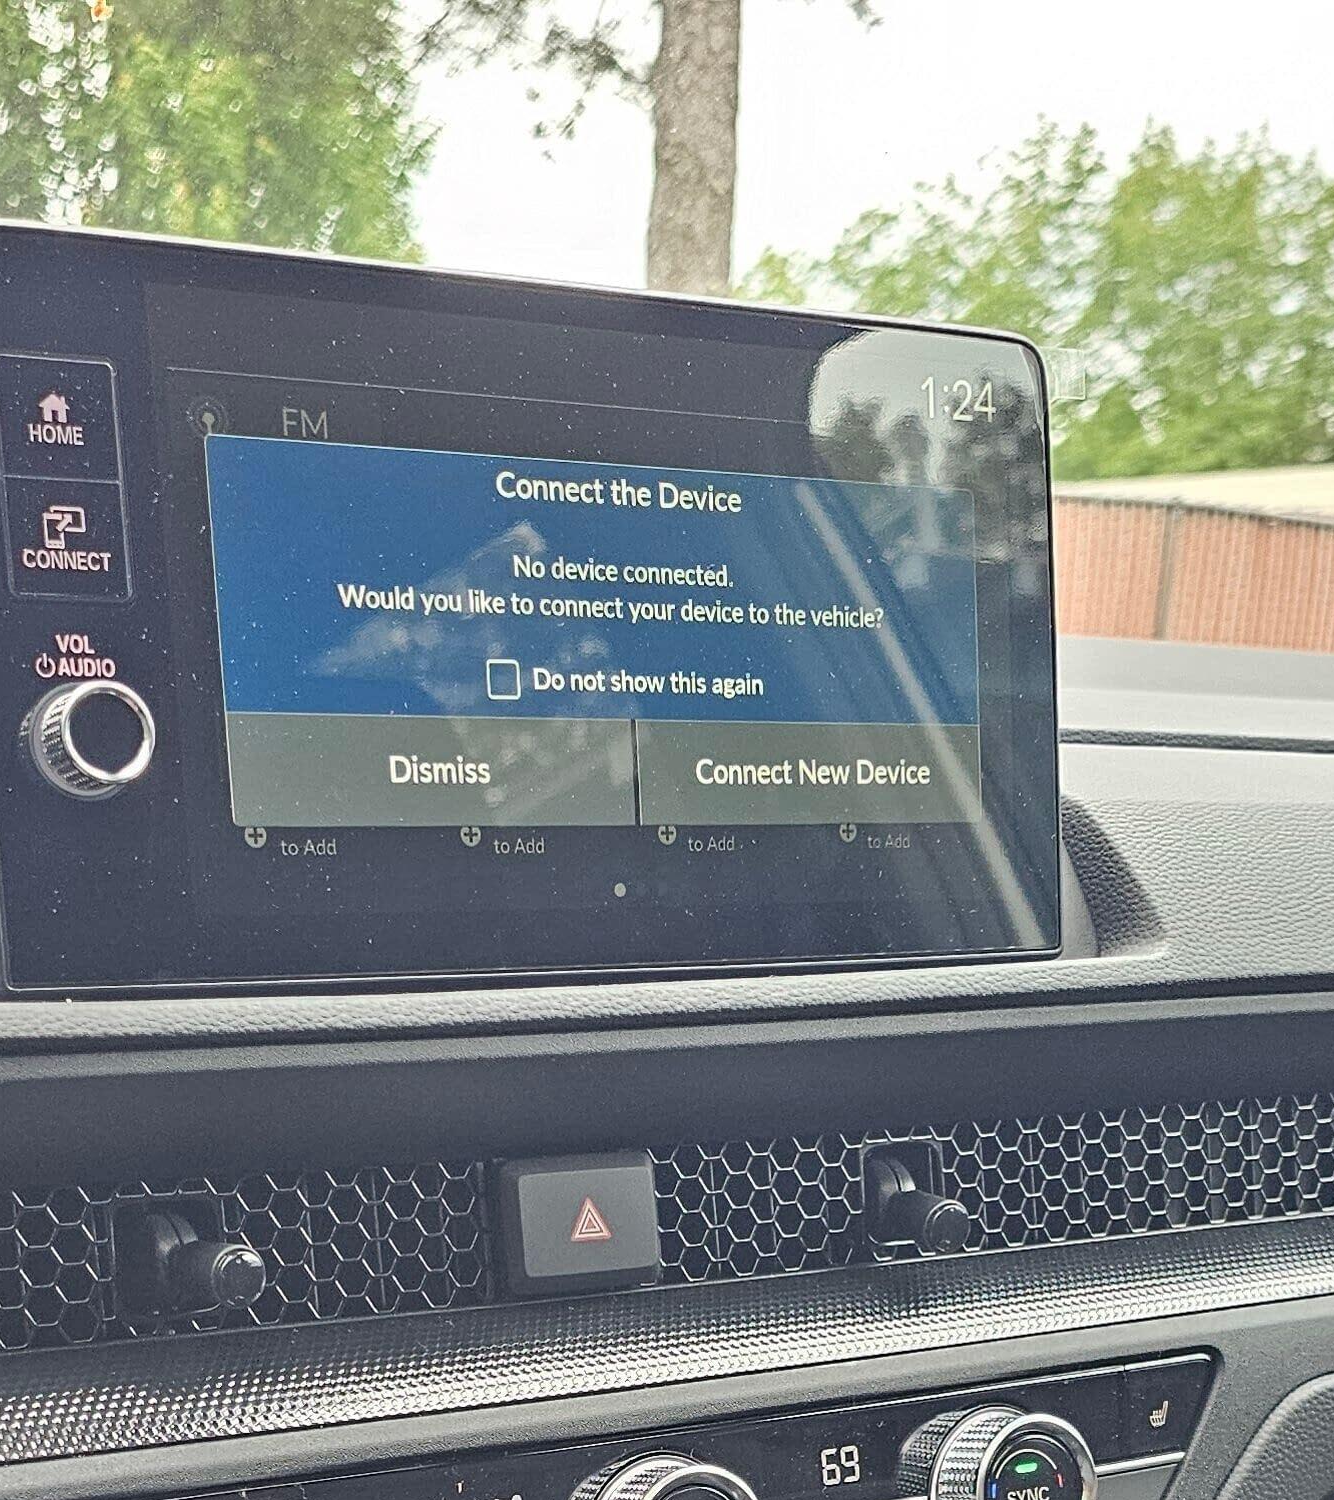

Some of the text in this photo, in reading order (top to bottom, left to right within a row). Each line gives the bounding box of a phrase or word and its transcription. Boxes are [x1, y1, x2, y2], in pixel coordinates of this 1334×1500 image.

[919, 376, 997, 423] 1:24
[28, 423, 85, 446] HOME
[281, 408, 329, 440] FM
[495, 470, 742, 513] Connect the Device
[22, 549, 112, 571] CONNECT
[513, 554, 734, 588] No device connected.
[337, 583, 885, 629] Would you like to connect your device to the vehicle?
[54, 634, 96, 655] VOL
[57, 657, 116, 678] AUDIO
[532, 667, 764, 699] Do not show this again
[388, 754, 492, 785] Dismiss
[695, 757, 932, 786] Connect New Device
[280, 838, 337, 857] to Add
[492, 837, 546, 855] to Add
[687, 835, 736, 853] to Add
[867, 833, 911, 850] to Add
[820, 1445, 861, 1487] 69
